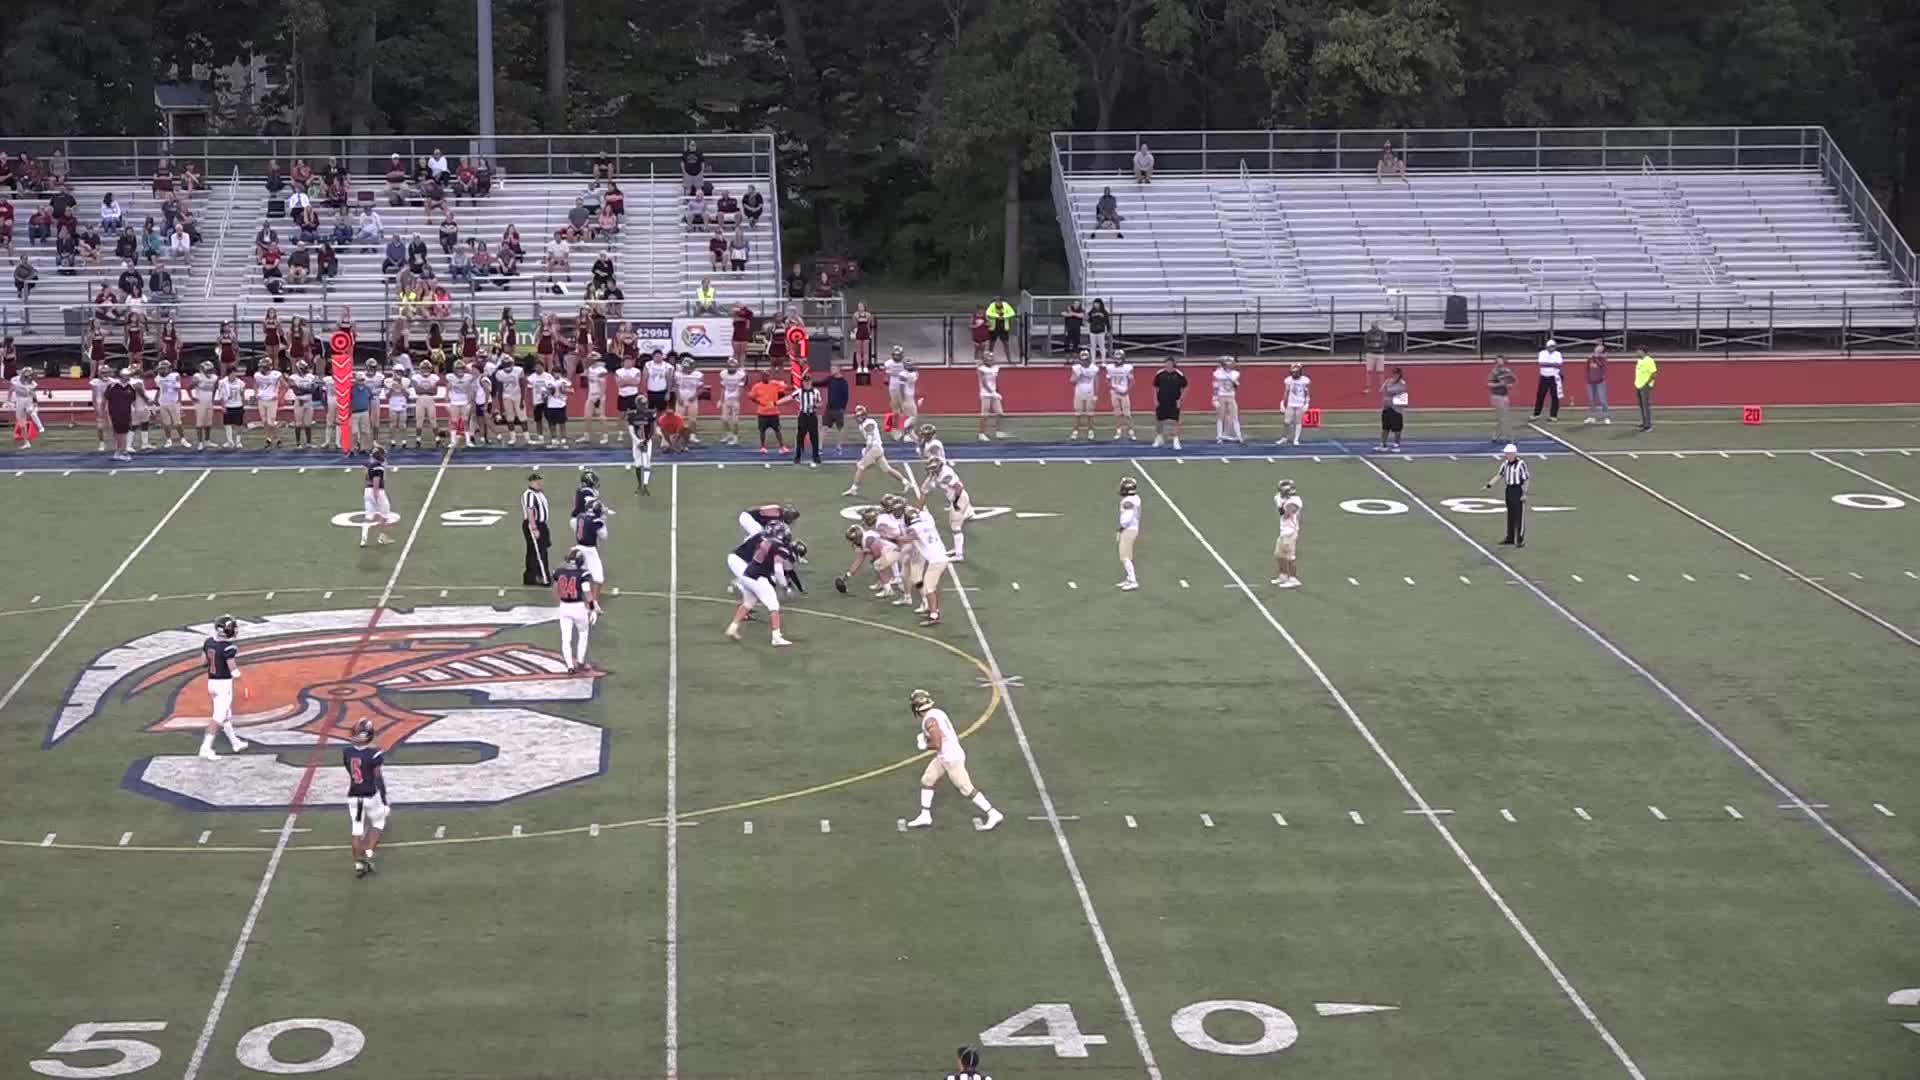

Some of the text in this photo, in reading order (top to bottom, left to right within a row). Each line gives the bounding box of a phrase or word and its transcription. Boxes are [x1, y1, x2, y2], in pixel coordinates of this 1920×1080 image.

[636, 328, 670, 338] $2998
[1303, 411, 1319, 425] 30
[1745, 408, 1760, 422] 20
